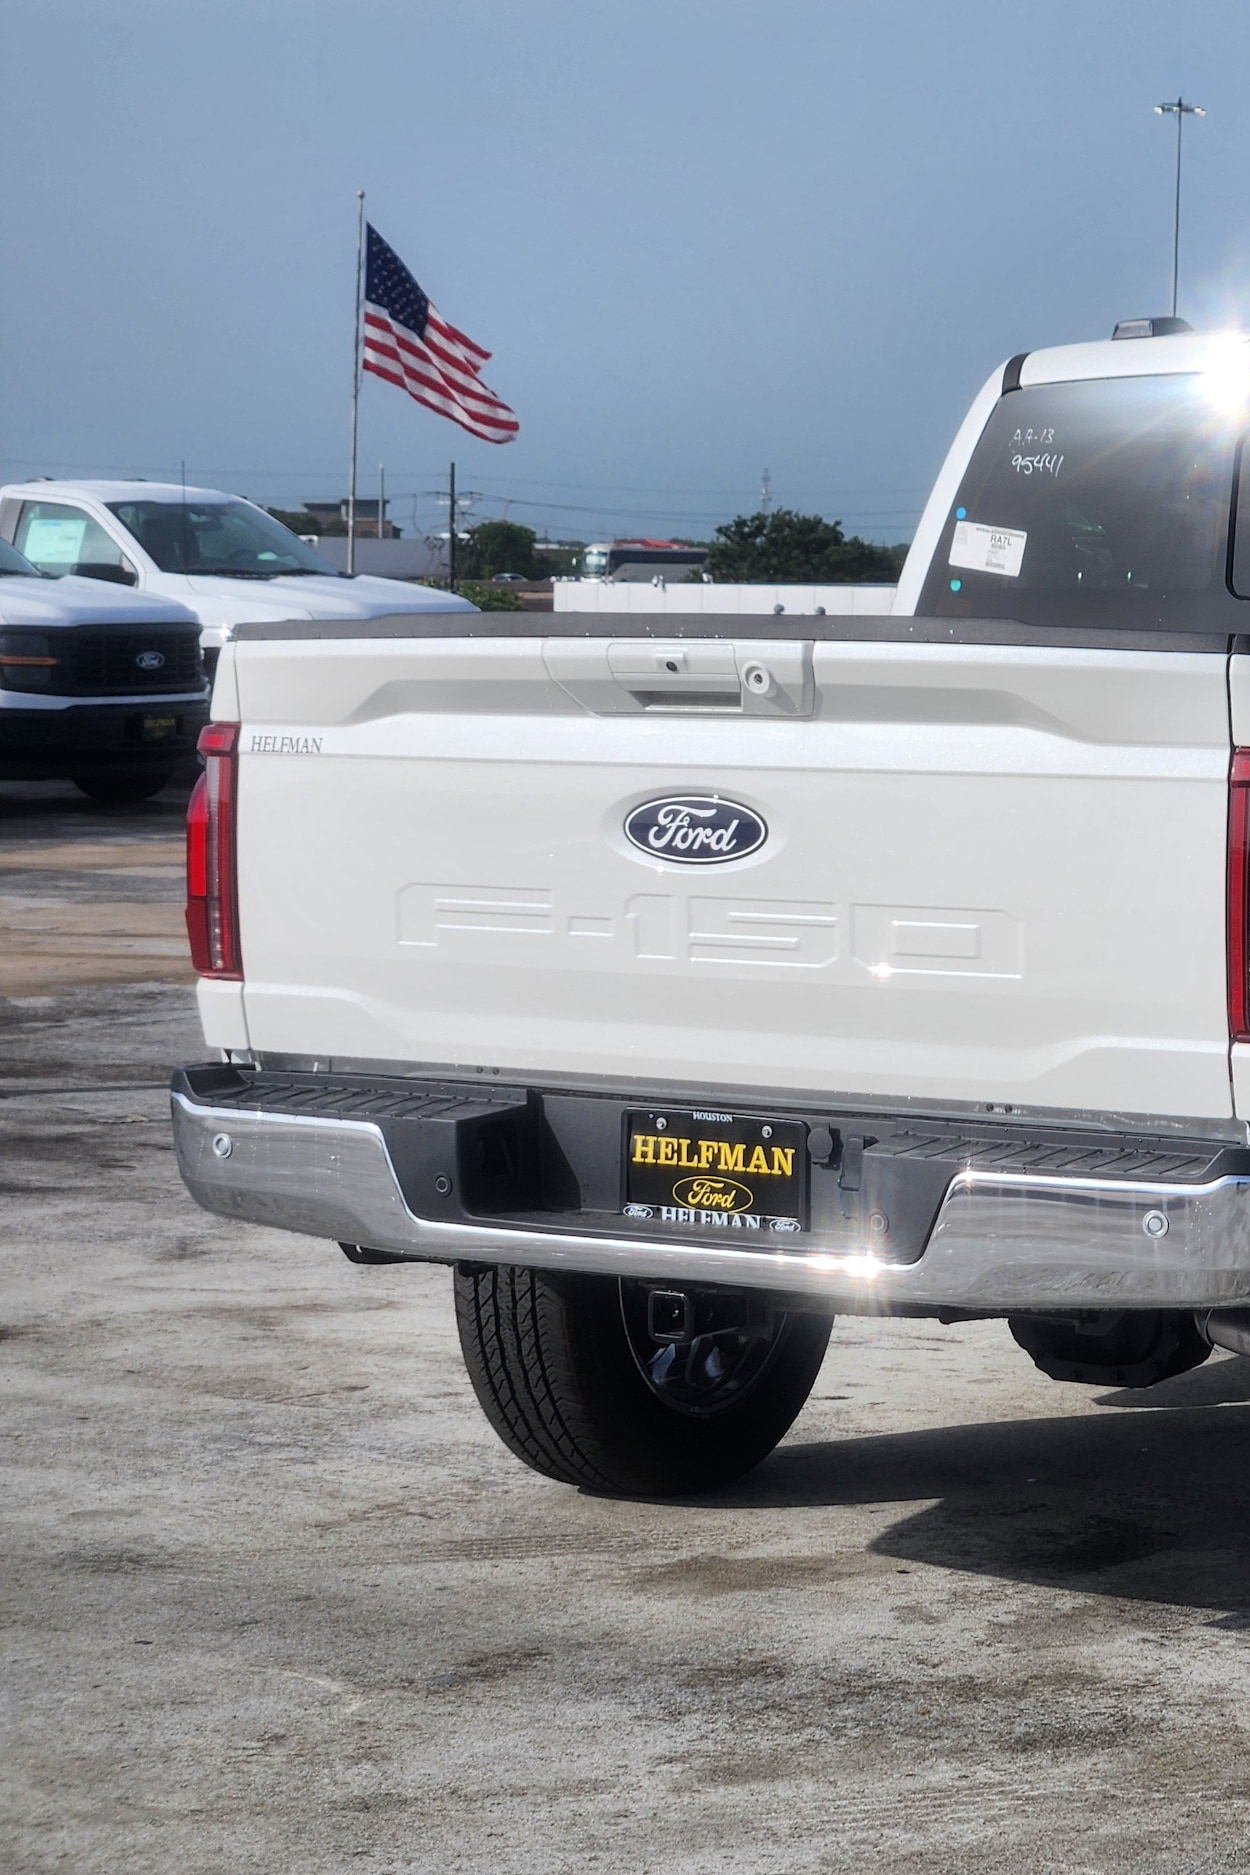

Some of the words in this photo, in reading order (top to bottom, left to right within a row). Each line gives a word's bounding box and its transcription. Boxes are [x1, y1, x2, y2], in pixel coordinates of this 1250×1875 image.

[990, 534, 1013, 546] RA7L
[250, 735, 324, 754] HELFMAN
[648, 804, 740, 852] Ford
[394, 881, 1024, 980] F-150
[692, 1111, 734, 1123] HOUSTON
[632, 1134, 796, 1178] HELFMAN
[687, 1178, 737, 1209] Ford
